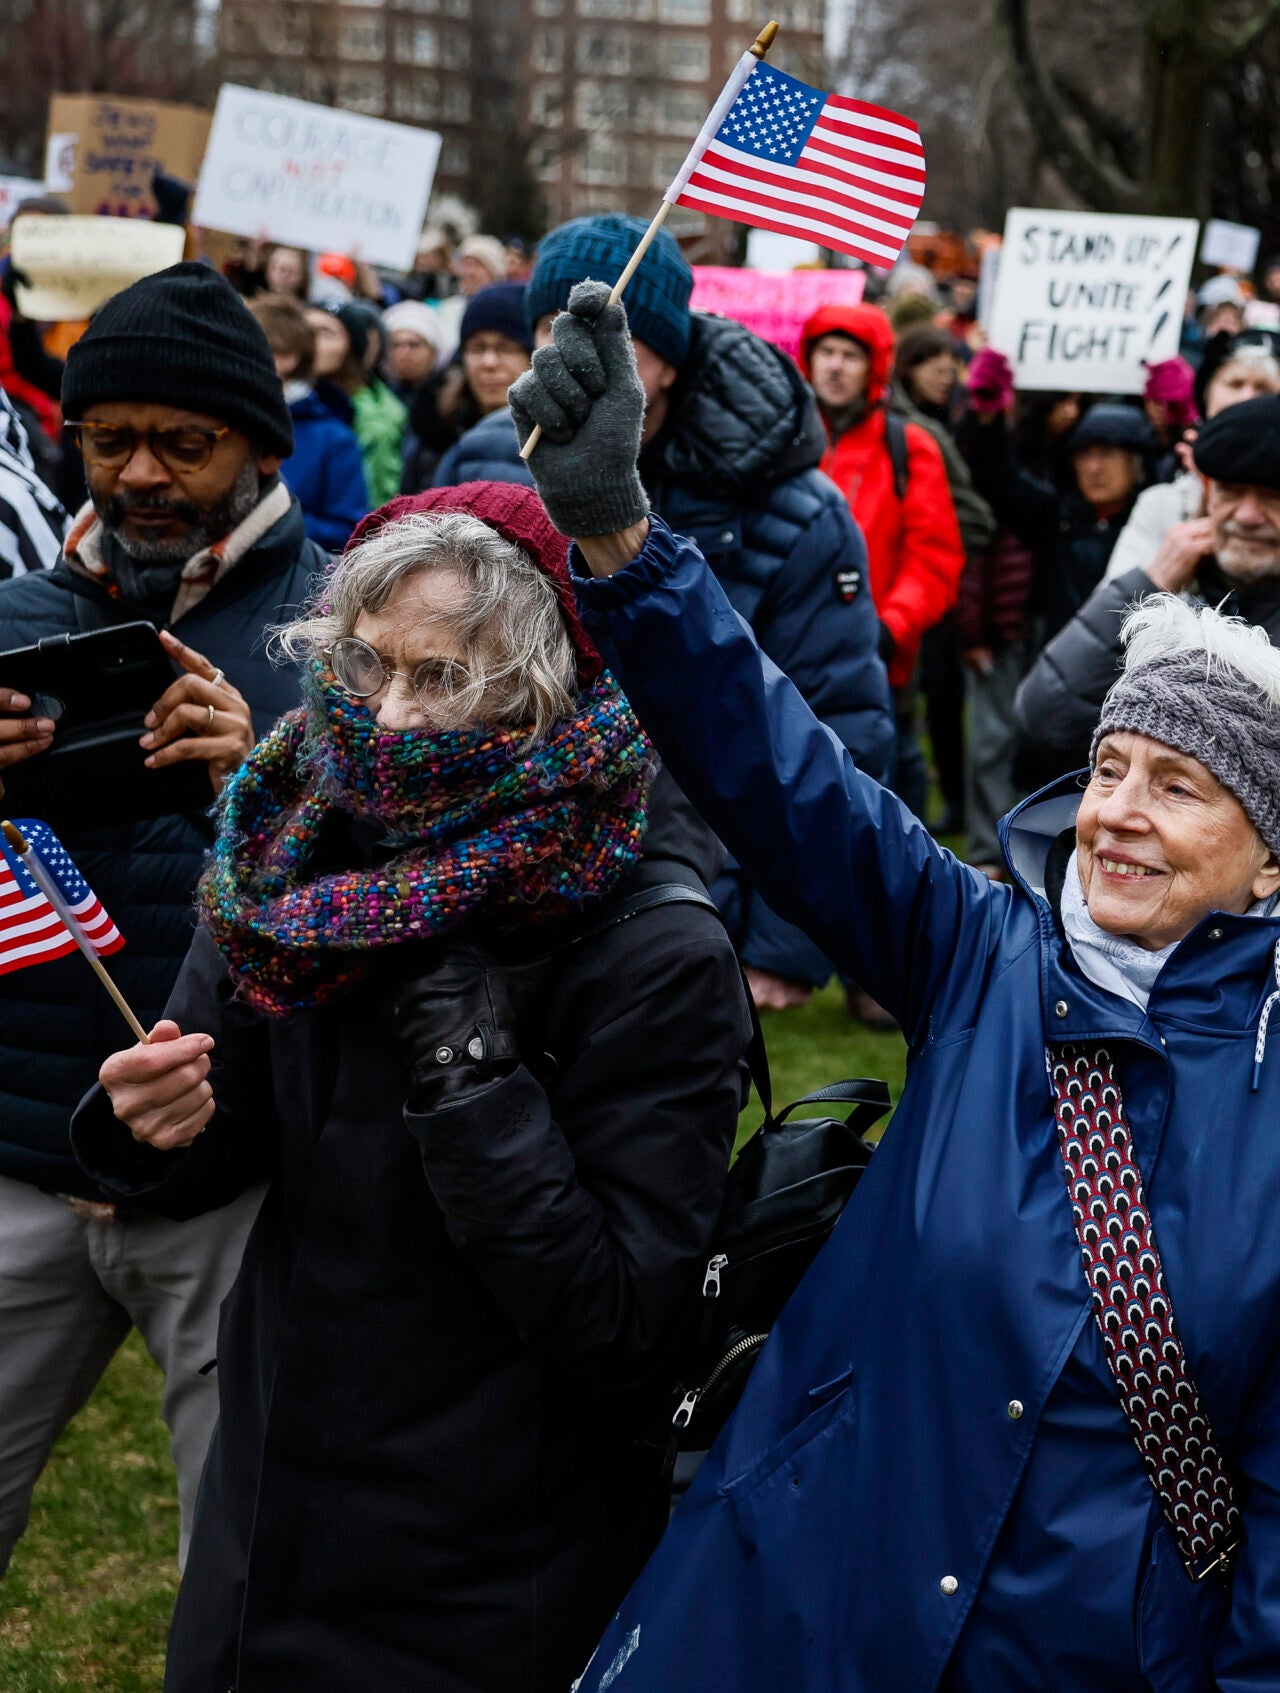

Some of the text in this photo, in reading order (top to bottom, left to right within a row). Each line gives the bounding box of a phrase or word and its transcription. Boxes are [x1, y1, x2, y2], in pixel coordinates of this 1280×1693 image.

[284, 158, 344, 185] NOT
[1021, 226, 1116, 266] STAND
[1125, 233, 1182, 272] UP!
[1048, 278, 1173, 311] UNITE!
[1017, 311, 1170, 367] FIGHT!
